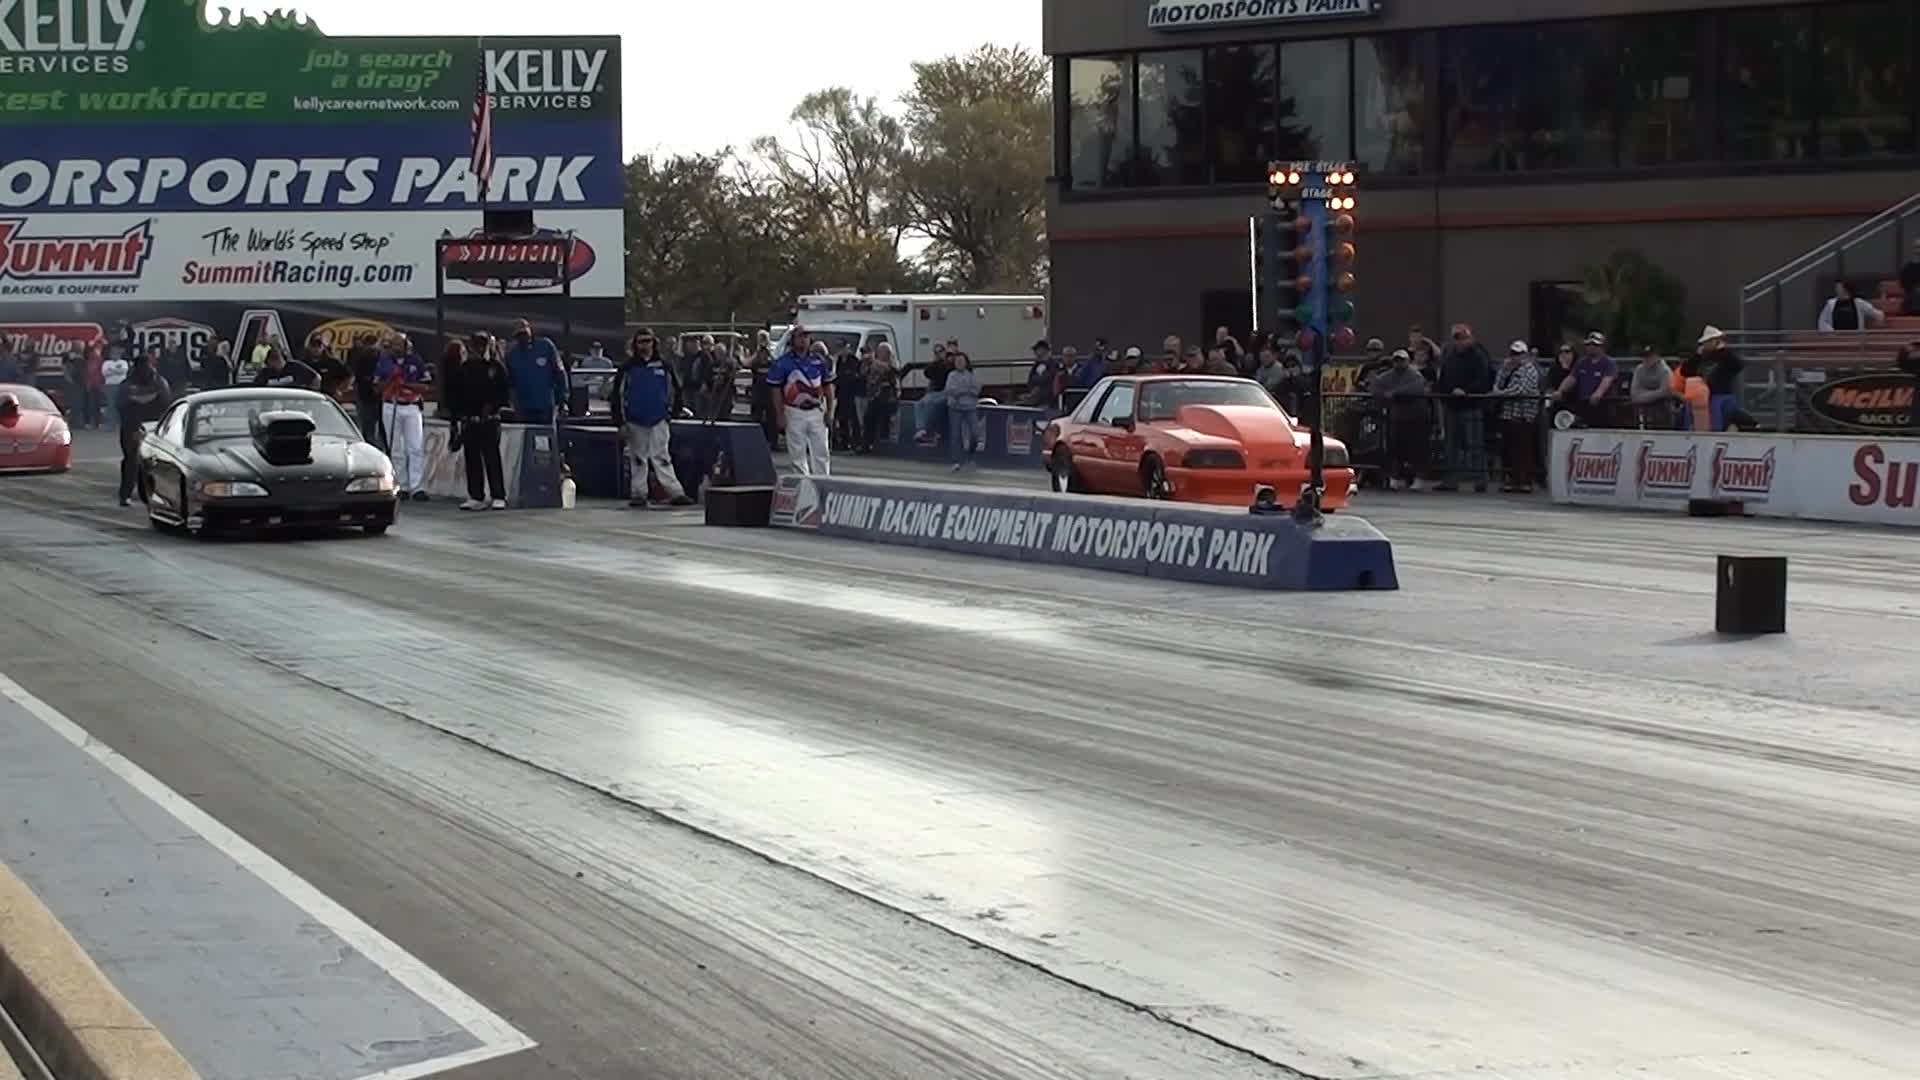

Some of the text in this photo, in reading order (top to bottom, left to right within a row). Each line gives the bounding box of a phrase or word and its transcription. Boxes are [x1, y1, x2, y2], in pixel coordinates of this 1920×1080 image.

[1151, 0, 1298, 24] MOTORSPORTS
[301, 49, 453, 72] job search
[485, 49, 607, 93] KELLY
[331, 70, 441, 93] a drag?
[0, 87, 268, 110] est workforce
[294, 96, 459, 112] kellycareernetwork.com
[486, 95, 592, 109] SERVICES
[391, 156, 595, 203] PARK
[202, 227, 390, 259] The World's Speed Shop
[182, 260, 413, 287] SummitRacing.com
[2, 285, 139, 295] RACING EQUIPMENT
[822, 492, 1275, 575] SUMMIT RACING EQUIPMENT MOTORSPORTS PARK
